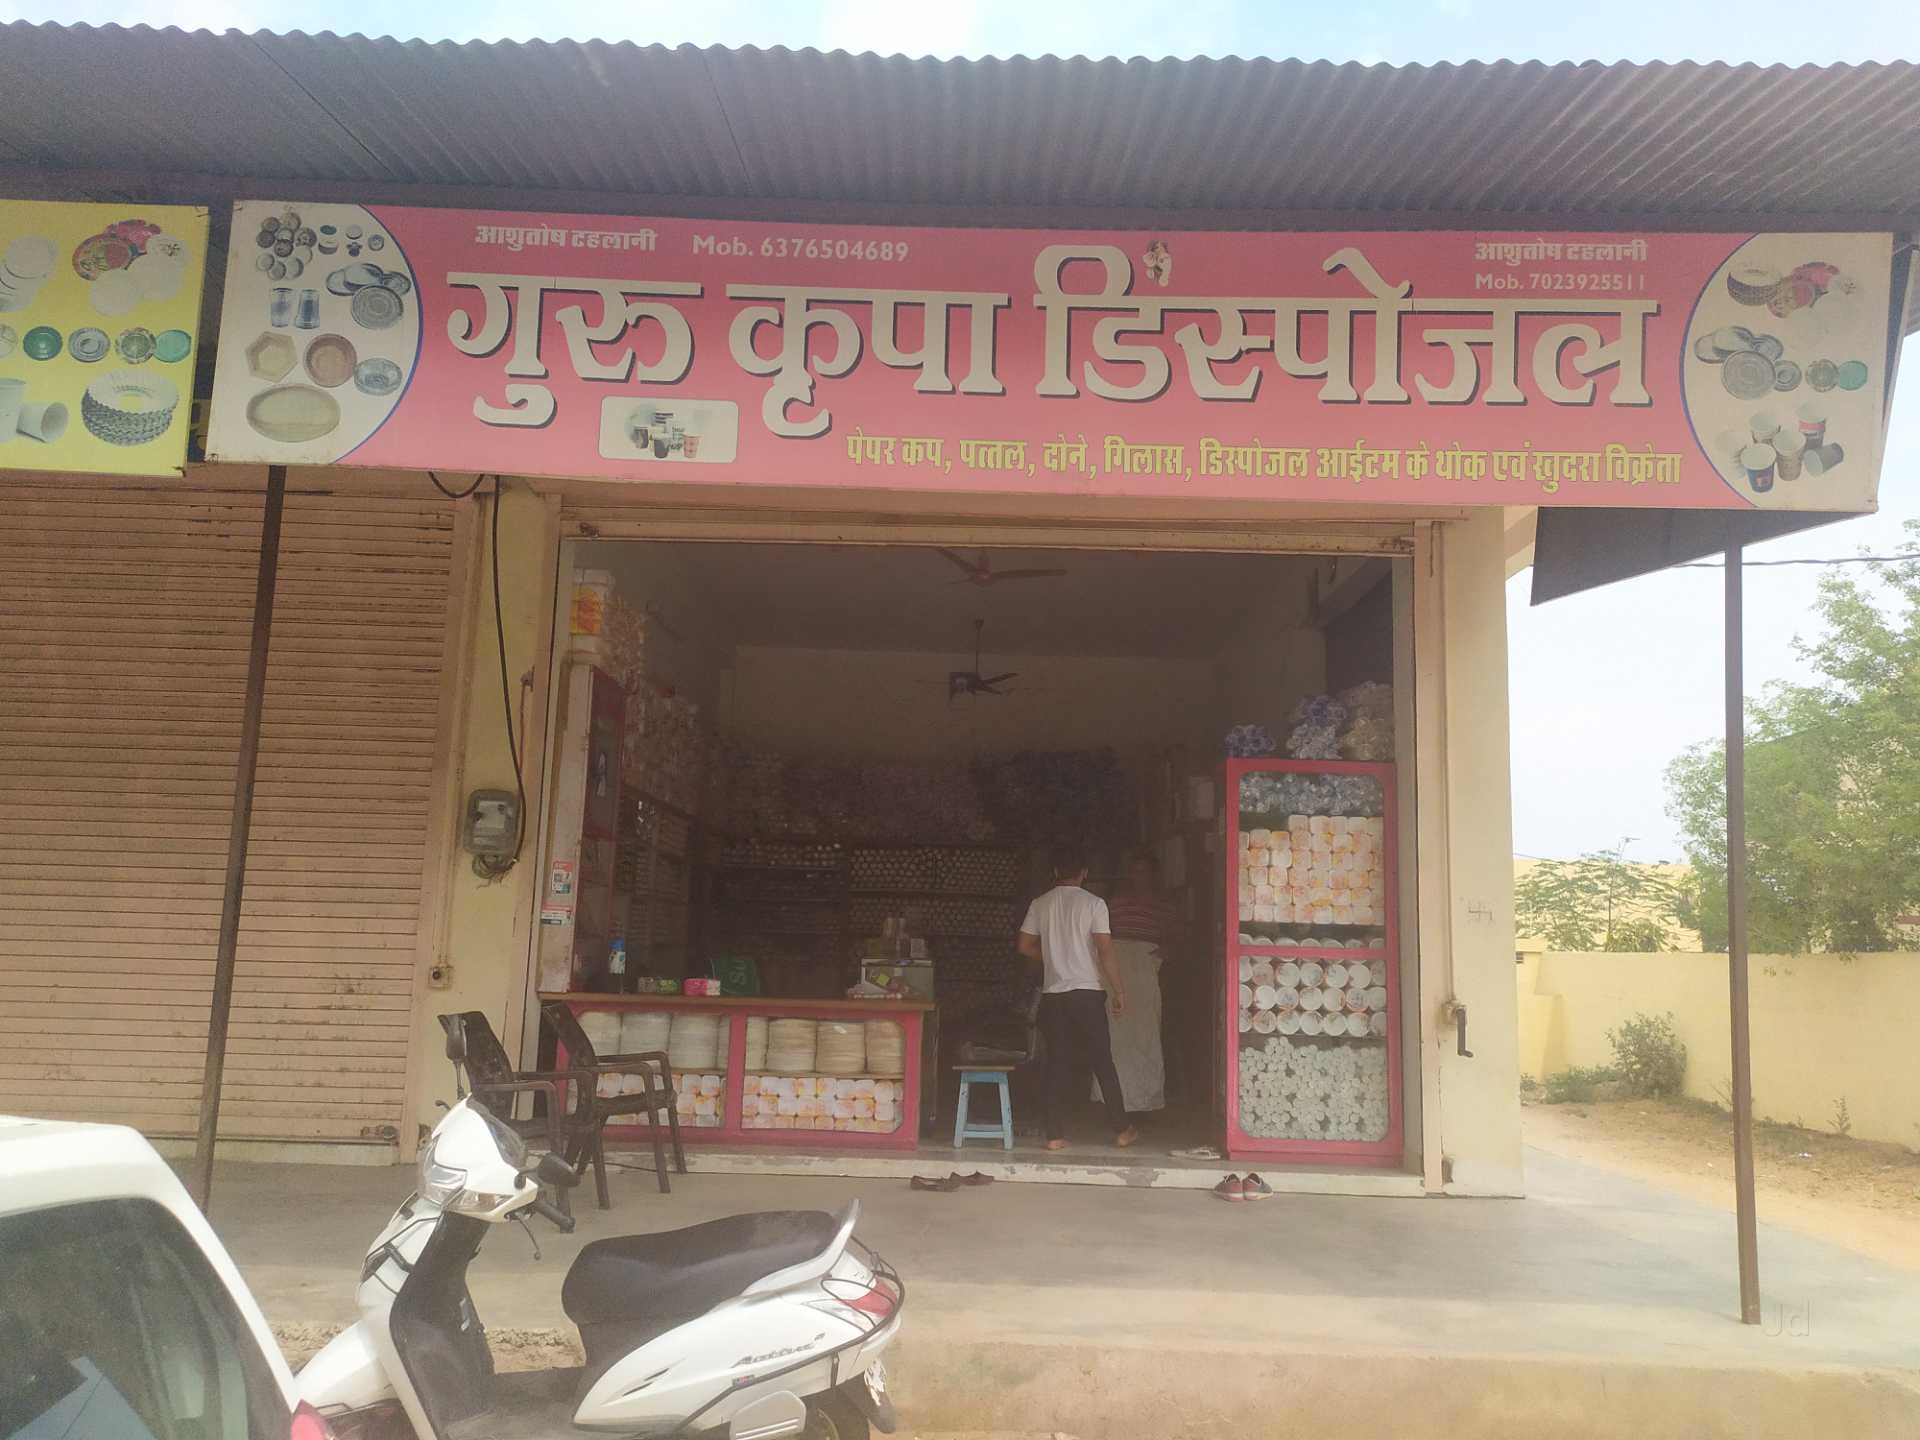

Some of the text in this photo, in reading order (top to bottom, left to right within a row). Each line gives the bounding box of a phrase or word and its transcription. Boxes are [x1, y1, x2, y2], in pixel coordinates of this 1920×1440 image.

[475, 224, 568, 251] आशुतोष
[692, 235, 753, 256] Mob.
[761, 237, 909, 261] 6376504689
[1475, 237, 1563, 266] आशुतोष
[1475, 273, 1644, 290] Mob. 7023925511
[725, 283, 1010, 438] कृपा
[1033, 245, 1659, 405] डिस्पोजल
[846, 426, 896, 465] पेपर
[901, 437, 952, 474] कप,
[1043, 432, 1097, 480] दोने,
[1103, 434, 1193, 482] गिलास,
[1199, 437, 1310, 477] डिस्पोजल
[1316, 439, 1400, 482] आईटम
[1405, 440, 1430, 480] के
[1492, 441, 1529, 481] एवं
[1604, 441, 1682, 486] विक्रेता
